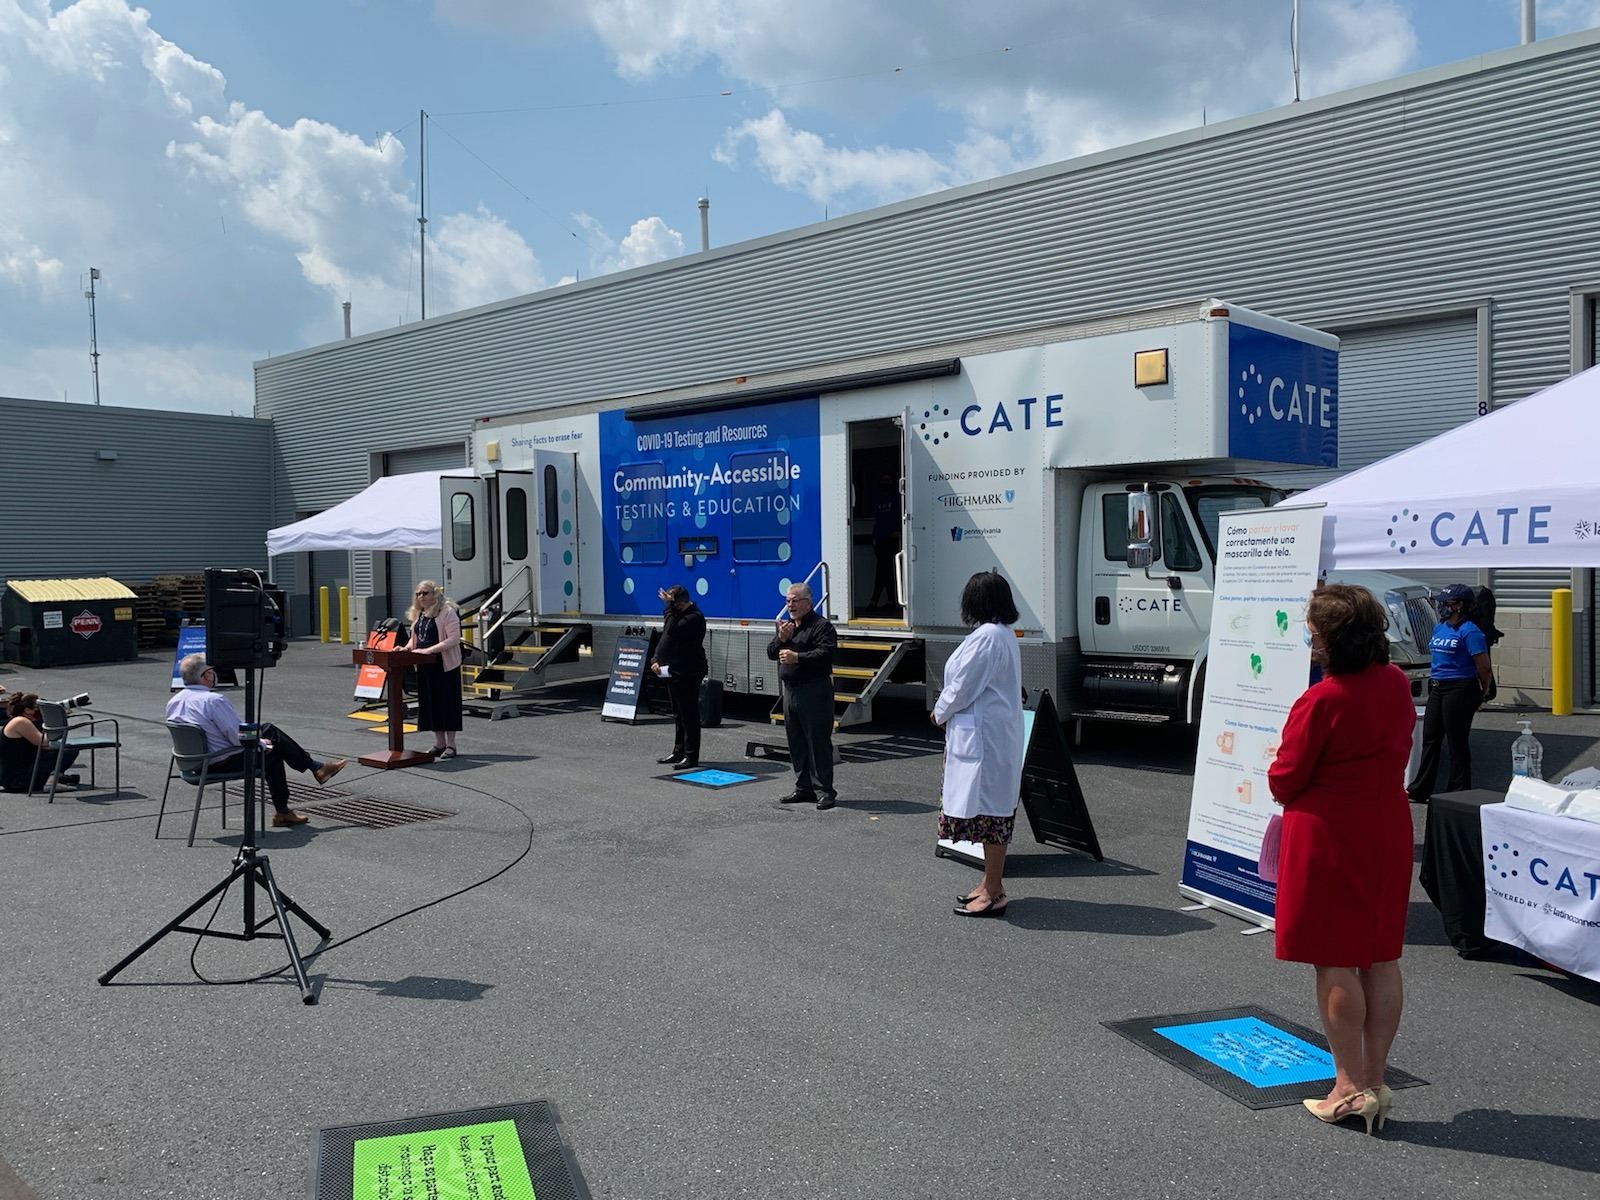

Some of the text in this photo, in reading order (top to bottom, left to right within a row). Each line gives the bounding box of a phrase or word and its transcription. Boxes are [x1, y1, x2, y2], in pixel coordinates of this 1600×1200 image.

[1268, 377, 1331, 428] CATE
[1479, 401, 1487, 416] 8
[960, 394, 1063, 436] CATE
[511, 437, 532, 448] Sharing
[533, 435, 547, 444] facts
[555, 434, 570, 442] erase
[571, 430, 583, 440] fear
[637, 424, 768, 451] COVID-19 Testing and Resources
[613, 455, 801, 496] Community-Accessible
[928, 467, 1025, 482] FUNDING PROVIDED BY
[615, 494, 801, 520] TESTING & EDUCATION
[944, 493, 1002, 506] HIGHMARK
[964, 527, 1001, 535] pennsylvania
[1227, 523, 1299, 535] Cómo portar y lavar
[1430, 505, 1551, 548] CATE
[1226, 536, 1295, 547] correctamente una
[1224, 547, 1291, 558] mascarilla de tela.
[1137, 598, 1181, 611] CATE
[1433, 638, 1458, 647] CATE
[1529, 858, 1600, 901] CAT
[1527, 900, 1539, 908] BY
